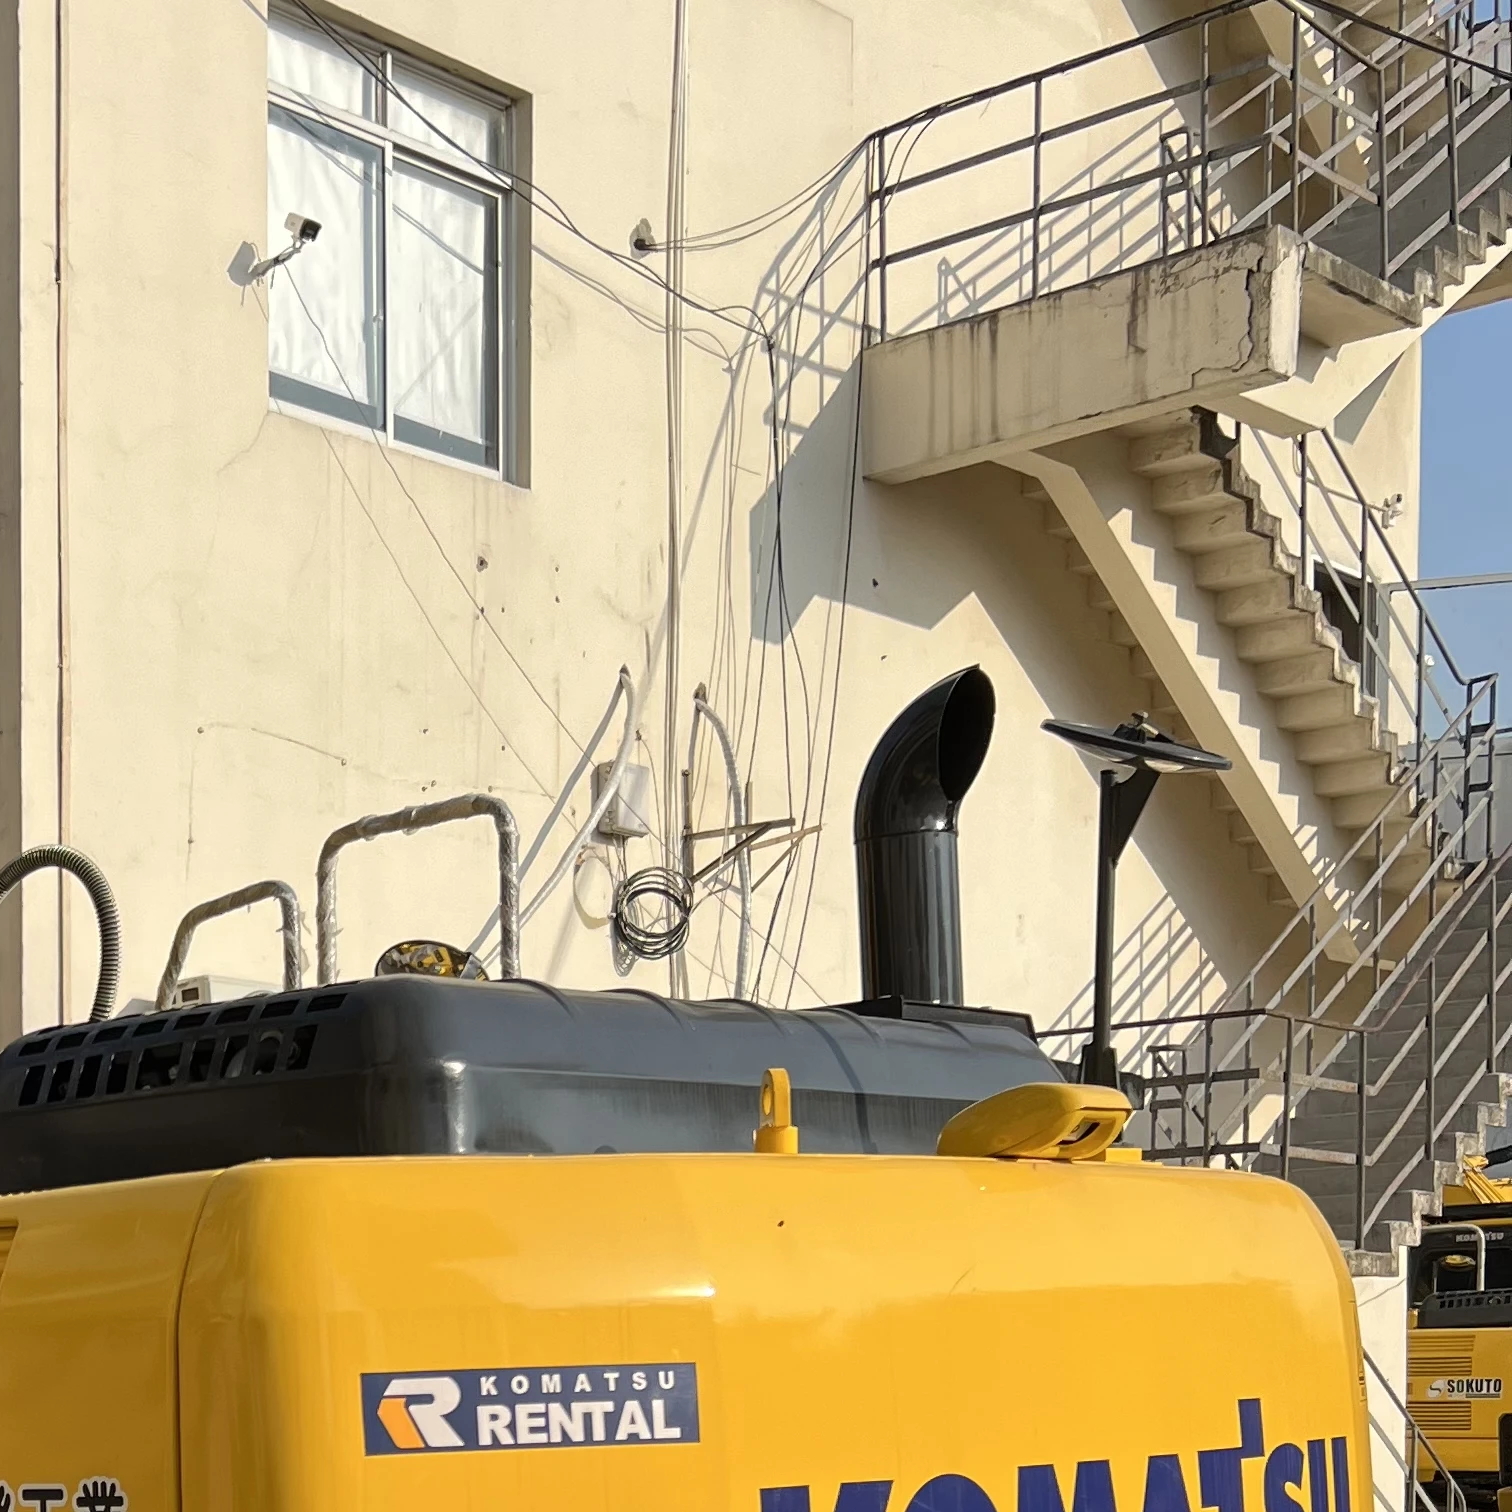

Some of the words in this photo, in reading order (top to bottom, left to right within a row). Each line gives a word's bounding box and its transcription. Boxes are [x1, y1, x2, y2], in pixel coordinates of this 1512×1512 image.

[1455, 1231, 1505, 1243] KOMTSU
[479, 1370, 675, 1396] KOMATSU
[1447, 1378, 1502, 1393] SOKUTO
[476, 1399, 682, 1446] RENTAL
